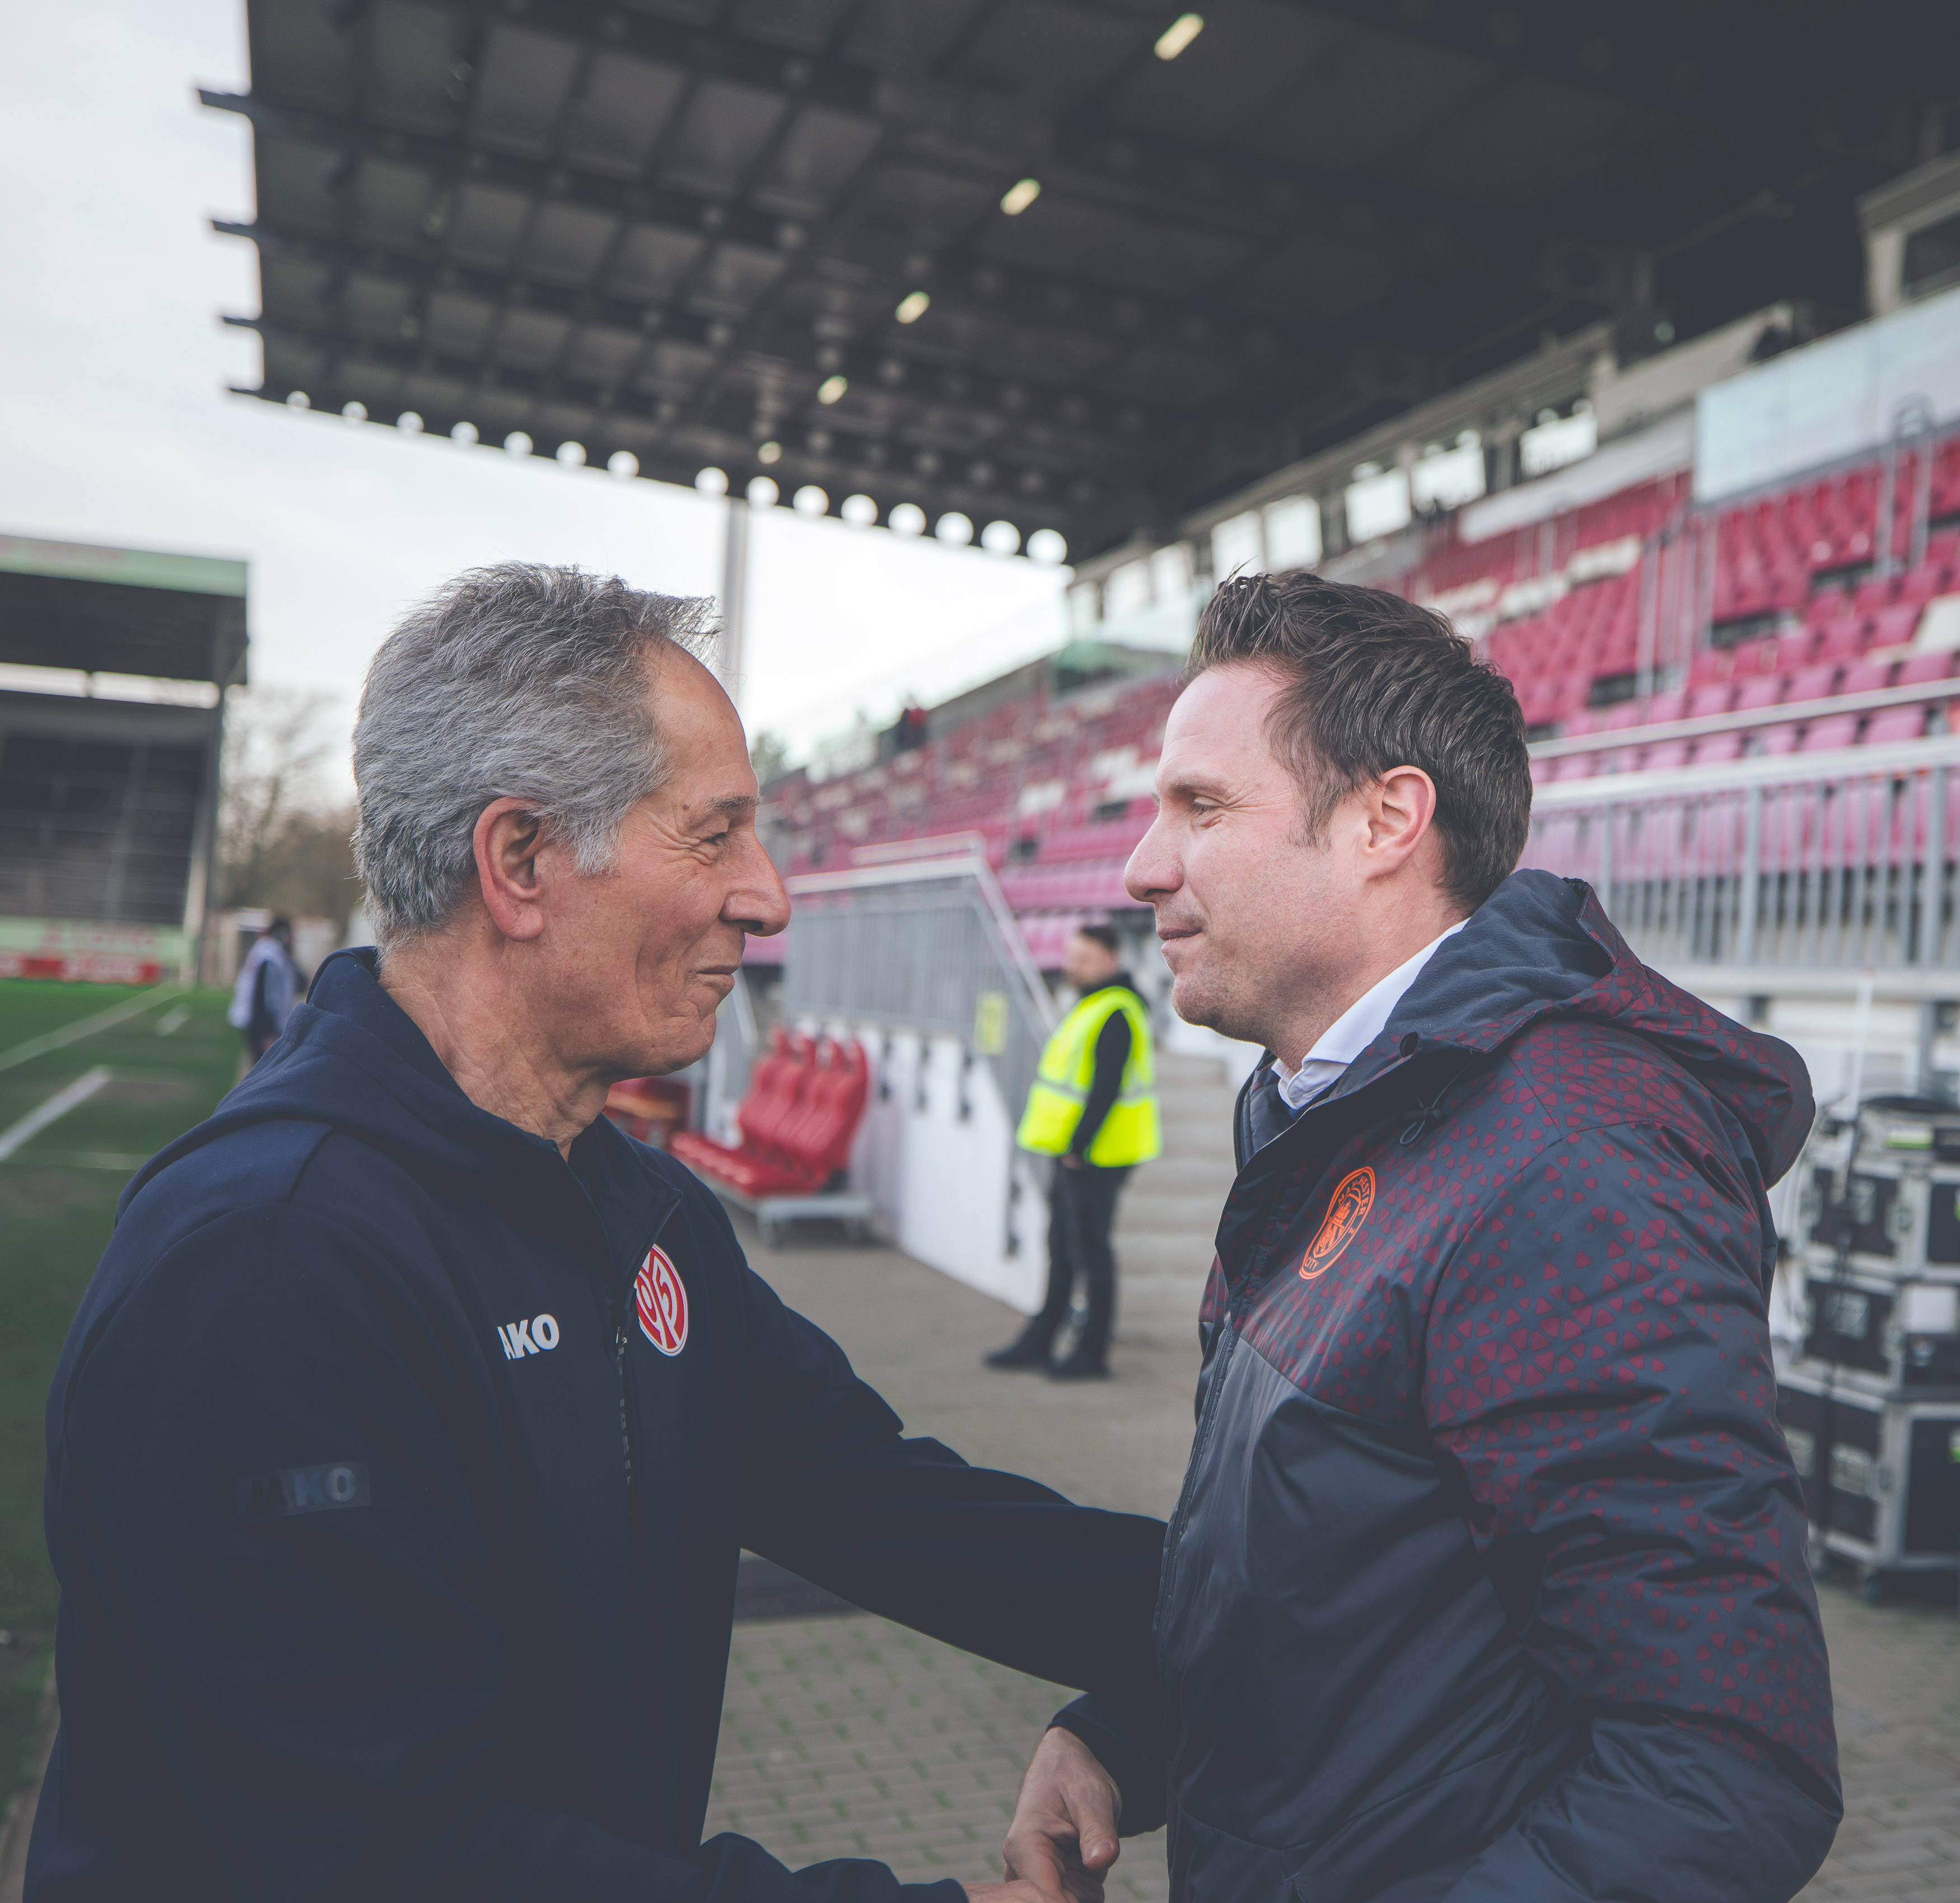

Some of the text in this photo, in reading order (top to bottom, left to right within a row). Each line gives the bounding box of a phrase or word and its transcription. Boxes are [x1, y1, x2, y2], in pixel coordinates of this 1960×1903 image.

[1305, 1256, 1319, 1271] CITY
[497, 1313, 559, 1360] AKO
[248, 1467, 357, 1514] JAKO
